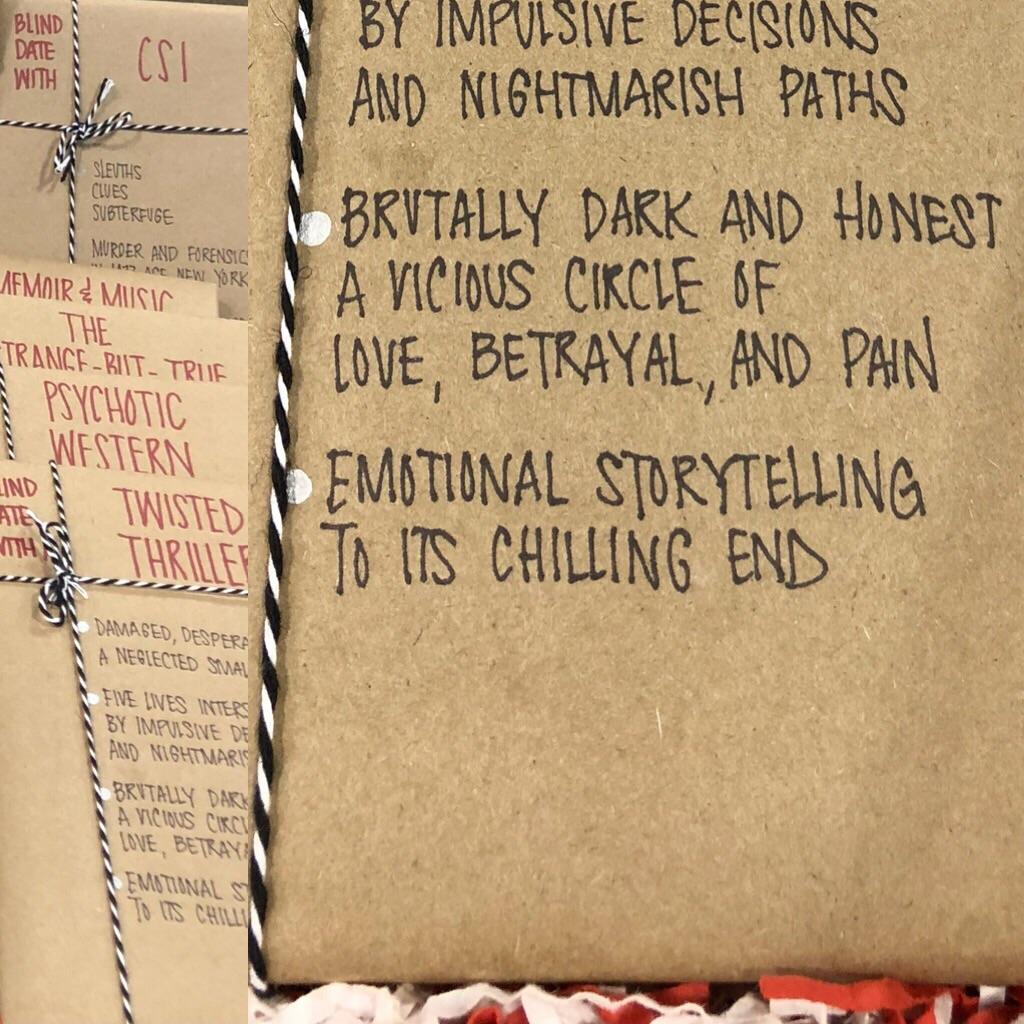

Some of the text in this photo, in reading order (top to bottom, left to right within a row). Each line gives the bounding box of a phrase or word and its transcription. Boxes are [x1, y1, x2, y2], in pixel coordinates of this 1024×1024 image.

[14, 13, 62, 35] BLIND
[15, 39, 55, 60] DATE
[139, 37, 187, 82] CSI
[14, 68, 56, 90] WITH
[460, 64, 907, 126] NIGHTMARISH PATHS
[94, 160, 141, 180] SLEUTHS
[92, 182, 128, 200] CLUES
[93, 204, 173, 225] SUBTERFUGE
[341, 180, 1002, 249] BRUTALLY DARK HONEST
[92, 239, 144, 258] MURDER
[388, 256, 703, 314] VICIOUS CIRCLE
[59, 312, 112, 346] THE
[842, 316, 938, 392] PAIN
[44, 381, 186, 430] PSYCHOTIC
[49, 429, 194, 478] WESTERN
[327, 445, 926, 521] EMOTIONAL STORYTELLING
[112, 488, 244, 535] TWISTED
[401, 525, 828, 593] ITS CHILLING END
[116, 647, 198, 671] NEGLECTED
[136, 716, 220, 740] IMPULSIVE
[113, 781, 194, 808] BRUTALLY
[136, 808, 195, 830] VICIOUS
